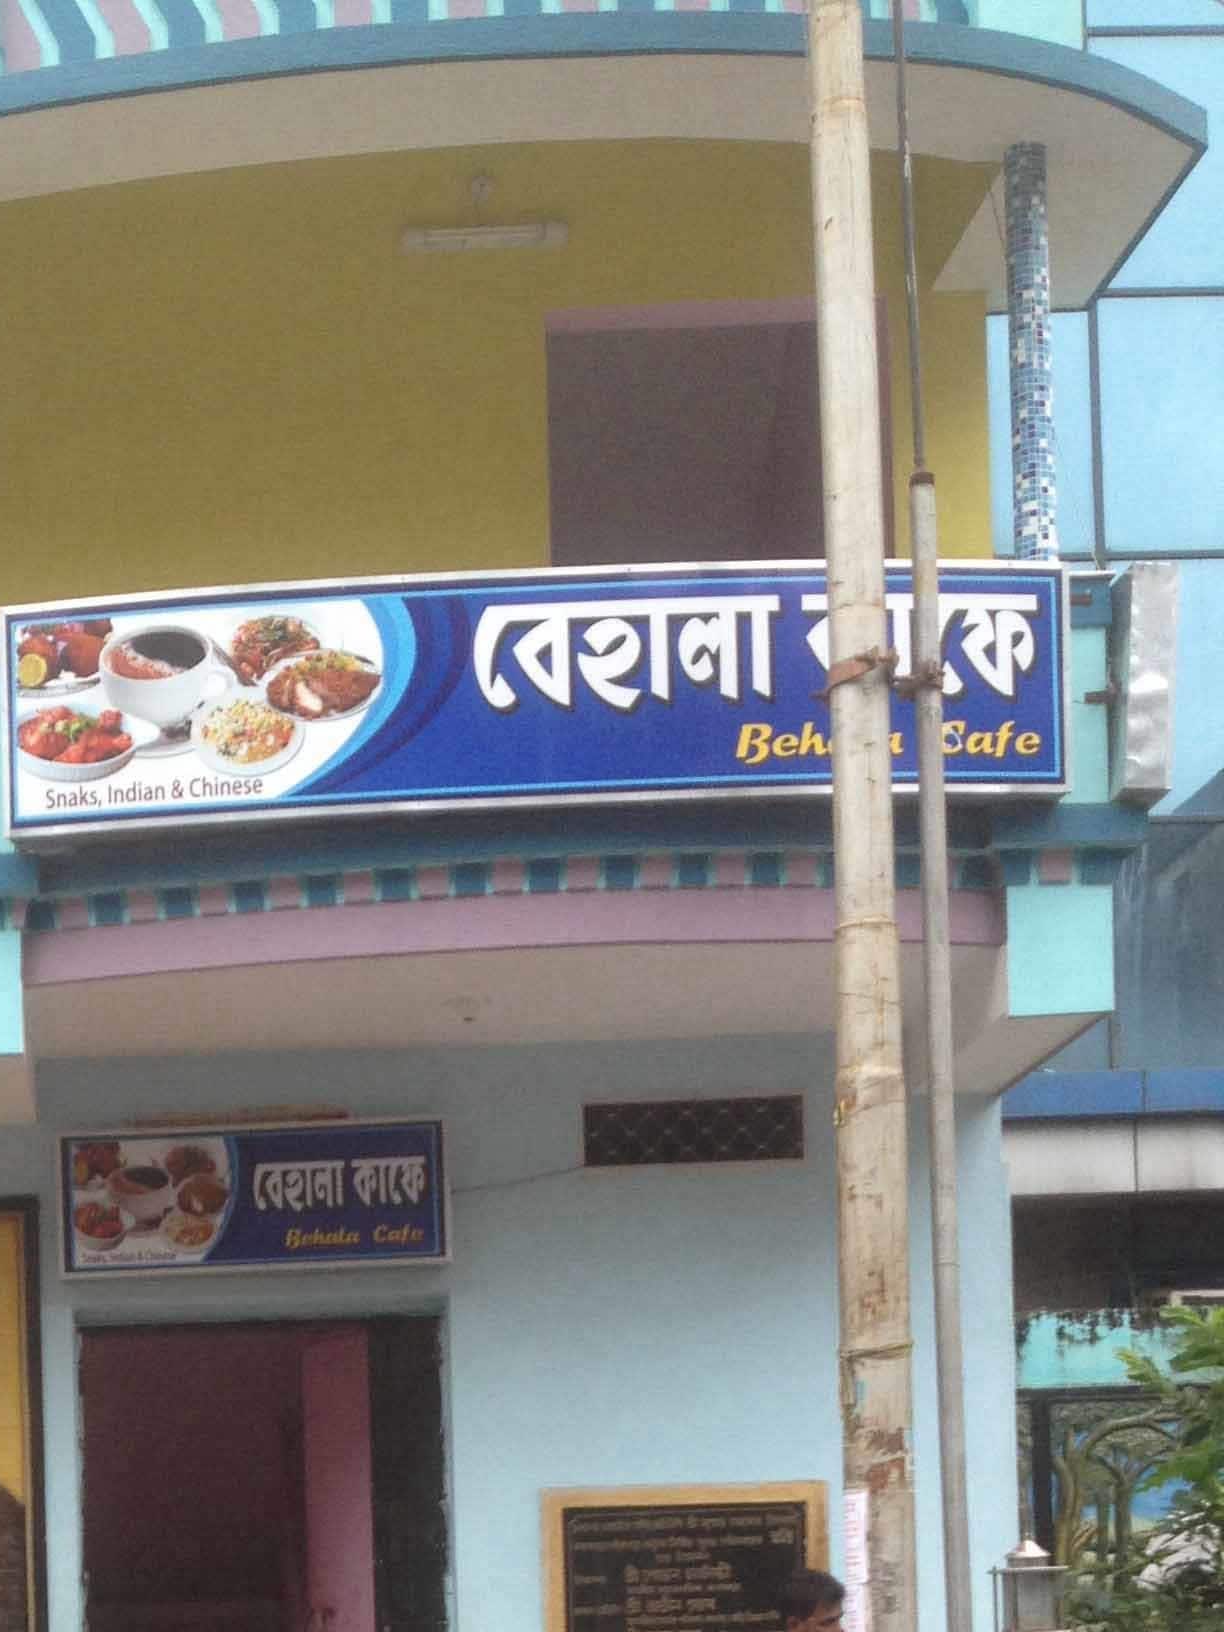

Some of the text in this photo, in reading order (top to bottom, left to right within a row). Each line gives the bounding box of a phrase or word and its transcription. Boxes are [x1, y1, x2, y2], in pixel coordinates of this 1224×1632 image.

[473, 594, 779, 709] বেহালা
[736, 721, 904, 763] Beha
[45, 777, 264, 809] Snaks, Indian & Chinese
[253, 1155, 425, 1212] বেহালা কাফে
[284, 1223, 425, 1249] Behala Cafe
